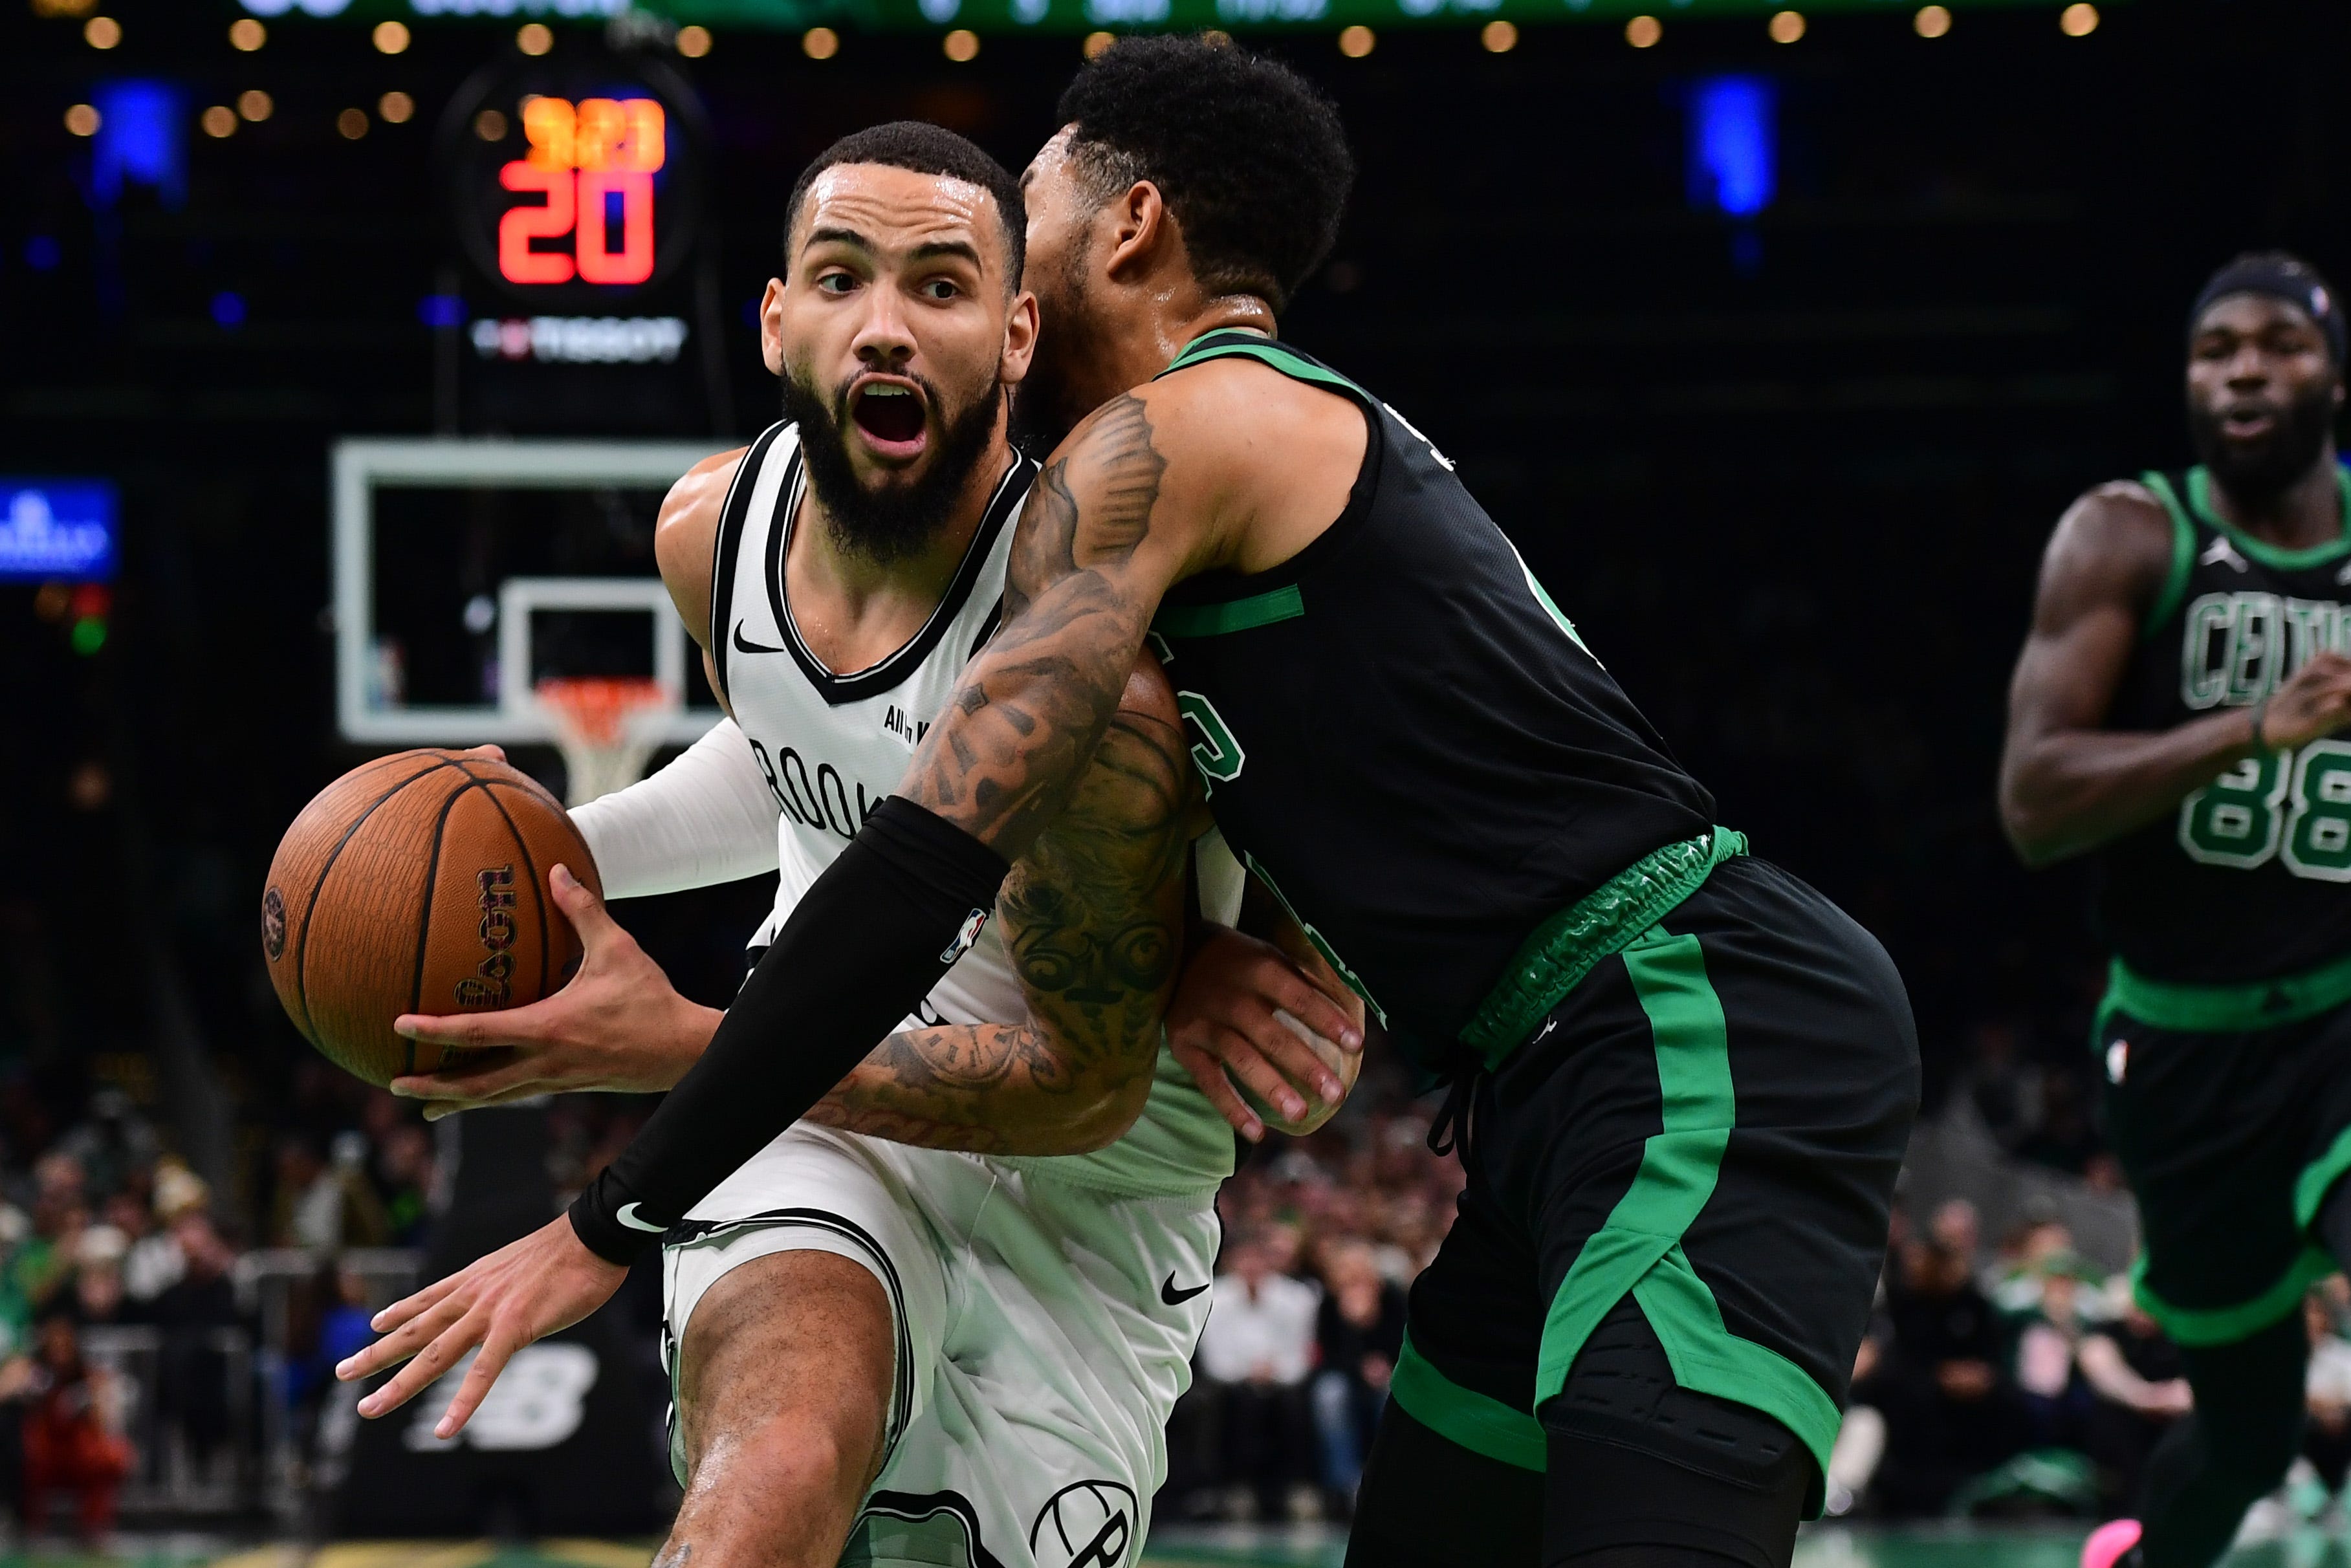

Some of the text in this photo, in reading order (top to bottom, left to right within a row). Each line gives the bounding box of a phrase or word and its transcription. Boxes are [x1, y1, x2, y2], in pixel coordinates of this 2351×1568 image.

[499, 160, 655, 284] 20
[884, 704, 904, 735] All
[2178, 739, 2351, 883] 88
[452, 864, 517, 1008] lson
